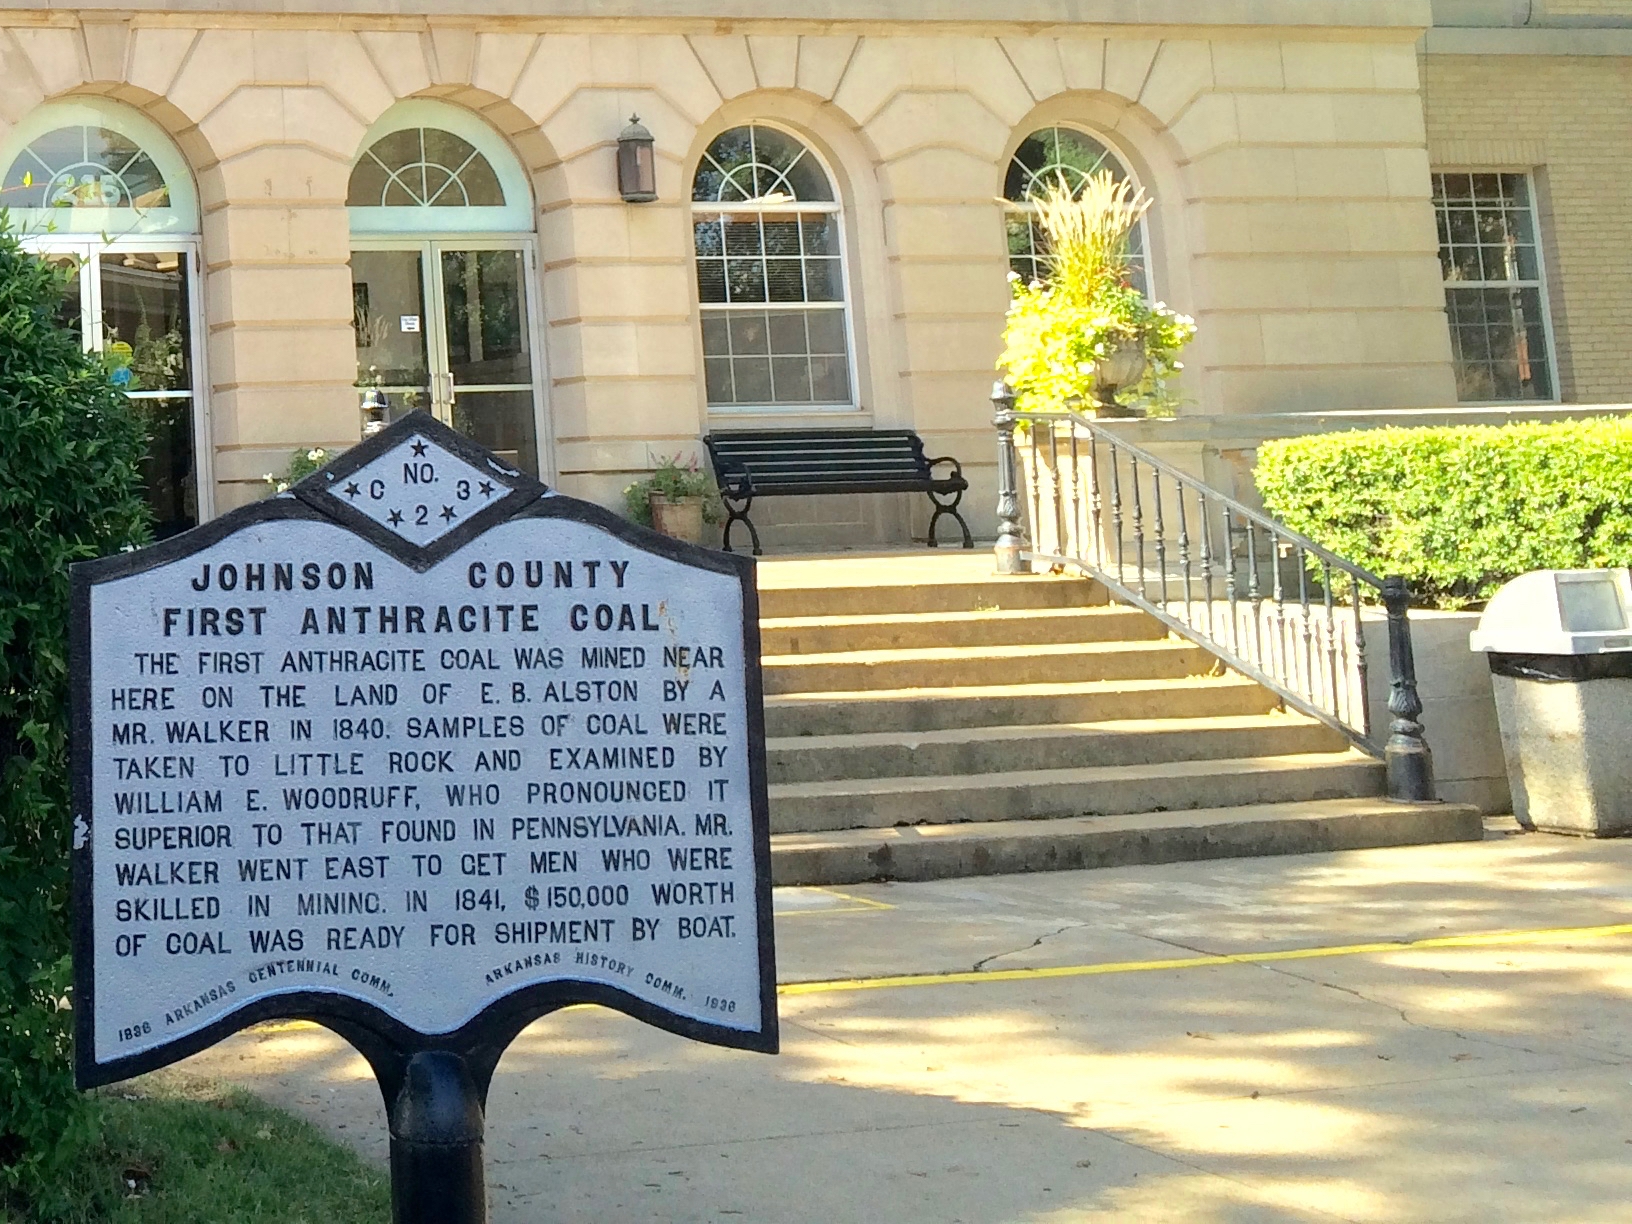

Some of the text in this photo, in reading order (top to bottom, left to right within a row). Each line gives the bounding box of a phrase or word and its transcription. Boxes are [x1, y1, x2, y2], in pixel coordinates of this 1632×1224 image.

[370, 479, 385, 500] C
[403, 462, 439, 484] NO.
[457, 480, 471, 500] 3
[415, 505, 428, 525] 2
[191, 561, 629, 591] JOHNSON COUNTY
[164, 604, 659, 637] FIRST ANTHRACITE COAL
[134, 646, 724, 675] THE FIRST ANTHRACITE COAL WAS MINED NEAR
[112, 680, 725, 710] HERE ON THE LAND OF E. B. ALSTON BY A
[113, 713, 726, 745] MR. WALKER IN 1840. SAMPLES OF COAL WERE
[113, 746, 727, 779] TAKEN TO LITTLE ROCK AND EXAMINED BY
[114, 779, 728, 815] WILLIAM E. WOODRUFF, WHO PRONOUNCED IT
[115, 814, 732, 850] SUPERIOR TO THAT FOUND IN PENNSYLVANIA. MR.
[116, 847, 732, 886] WALKER WENT EAST TO GET MEN WHO WERE
[116, 897, 219, 922] SKILLED
[249, 895, 269, 917] IN
[298, 893, 386, 915] MINING.
[407, 890, 427, 912] IN
[456, 889, 505, 911] 1841,
[651, 882, 733, 905] WORTH
[116, 916, 735, 957] OF COAL WAS READY FOR SHIPMENT BY BOAT.
[484, 951, 737, 1014] ARKANSAS HISTORY COMM. 1936
[118, 1022, 152, 1043] 1836
[165, 980, 236, 1027] ARKANSAS
[248, 959, 339, 984] CENTENNIAL
